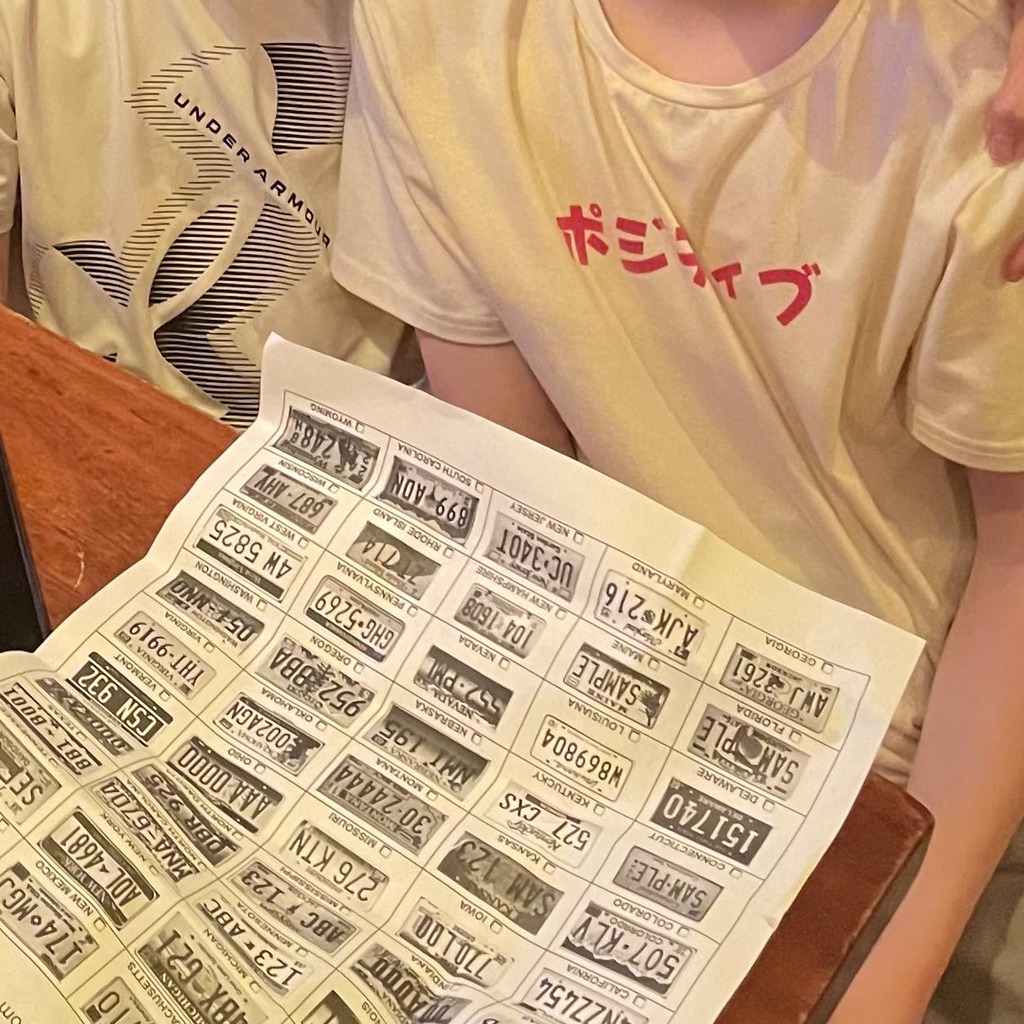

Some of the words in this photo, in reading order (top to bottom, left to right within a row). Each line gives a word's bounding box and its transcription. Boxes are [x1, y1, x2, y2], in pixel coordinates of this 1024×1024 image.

[174, 93, 250, 163] UNDER
[254, 168, 331, 248] ARMOUR
[308, 402, 353, 426] WYOMING
[277, 458, 326, 487] WISCONSIN
[395, 441, 443, 471] CAROLINA
[440, 465, 471, 486] SOUTH
[230, 497, 269, 523] VIRGINIA
[372, 506, 407, 530] ISLAND
[432, 494, 471, 527] 899
[509, 500, 546, 525] JERSEY
[545, 519, 570, 537] NEW
[208, 518, 263, 563] 5825
[268, 519, 296, 540] WEST
[406, 525, 442, 551] RHODE
[194, 560, 254, 602] WASHINGTON
[261, 551, 294, 582] 4W
[474, 564, 530, 599] HAMPSHIRE
[630, 561, 690, 599] MARYLAND
[334, 561, 405, 609] PENNSYLVANIA
[527, 593, 553, 612] NEW
[599, 580, 646, 620] 216
[313, 587, 361, 629] 5269
[163, 611, 202, 642] VIRGINIA
[360, 617, 395, 651] GHG
[651, 607, 700, 649] AJK
[127, 618, 205, 686] YHT-9919
[135, 646, 174, 681] VIRGINIA
[309, 635, 351, 665] OREGON
[457, 634, 497, 661] NEVADA
[610, 639, 644, 662] MAINE
[763, 635, 817, 667] GEORGIA
[76, 664, 119, 706] 932
[112, 651, 157, 691] VERMONT
[571, 653, 642, 706] SAMPLE
[115, 695, 158, 737] CSN
[259, 686, 313, 722] OKLAHOMA
[316, 678, 367, 719] 952
[431, 689, 474, 719] NEVADA
[565, 697, 625, 734] LOUISIANA
[586, 687, 628, 713] MAINE
[742, 684, 801, 720] GEORGIA
[786, 684, 829, 718] AWJ
[413, 699, 469, 737] NEBRASKA
[734, 702, 785, 734] FLORIDA
[226, 746, 252, 765] OHIO
[374, 756, 423, 791] MONTANA
[538, 727, 625, 787] W869804
[755, 746, 800, 784] SAM
[125, 779, 168, 826] CAROLINA
[226, 779, 272, 819] AAA
[531, 769, 590, 807] KENTUCKY
[695, 766, 759, 804] DELAWARE
[99, 810, 126, 838] YORK
[199, 803, 231, 831] NORTH
[343, 791, 396, 830] MONTANA
[497, 790, 542, 823] CXS
[660, 791, 758, 856] 151740
[59, 823, 107, 870] 4681
[167, 826, 197, 859] NORTH
[327, 811, 377, 848] MISSOURI
[550, 818, 592, 851] 527
[124, 838, 147, 861] NEW
[287, 828, 336, 871] KTN
[496, 833, 541, 863] KANSAS
[647, 830, 726, 870] CONNECTICUT
[33, 858, 71, 895] MEXICO
[279, 866, 339, 908] MISSISSIPPI
[331, 859, 379, 902] 276
[68, 891, 94, 916] NEW
[201, 897, 247, 938] ABC
[457, 899, 487, 923] IOWA
[611, 897, 673, 932] COLORADO
[33, 918, 84, 964] 174
[236, 900, 293, 947] MINNESOTA
[607, 915, 663, 947] COLORADO
[202, 928, 248, 978] MICHIGAN
[252, 948, 303, 986] 123
[125, 960, 178, 1021] ACHUSETTS
[565, 963, 630, 999] CALIFORNIA
